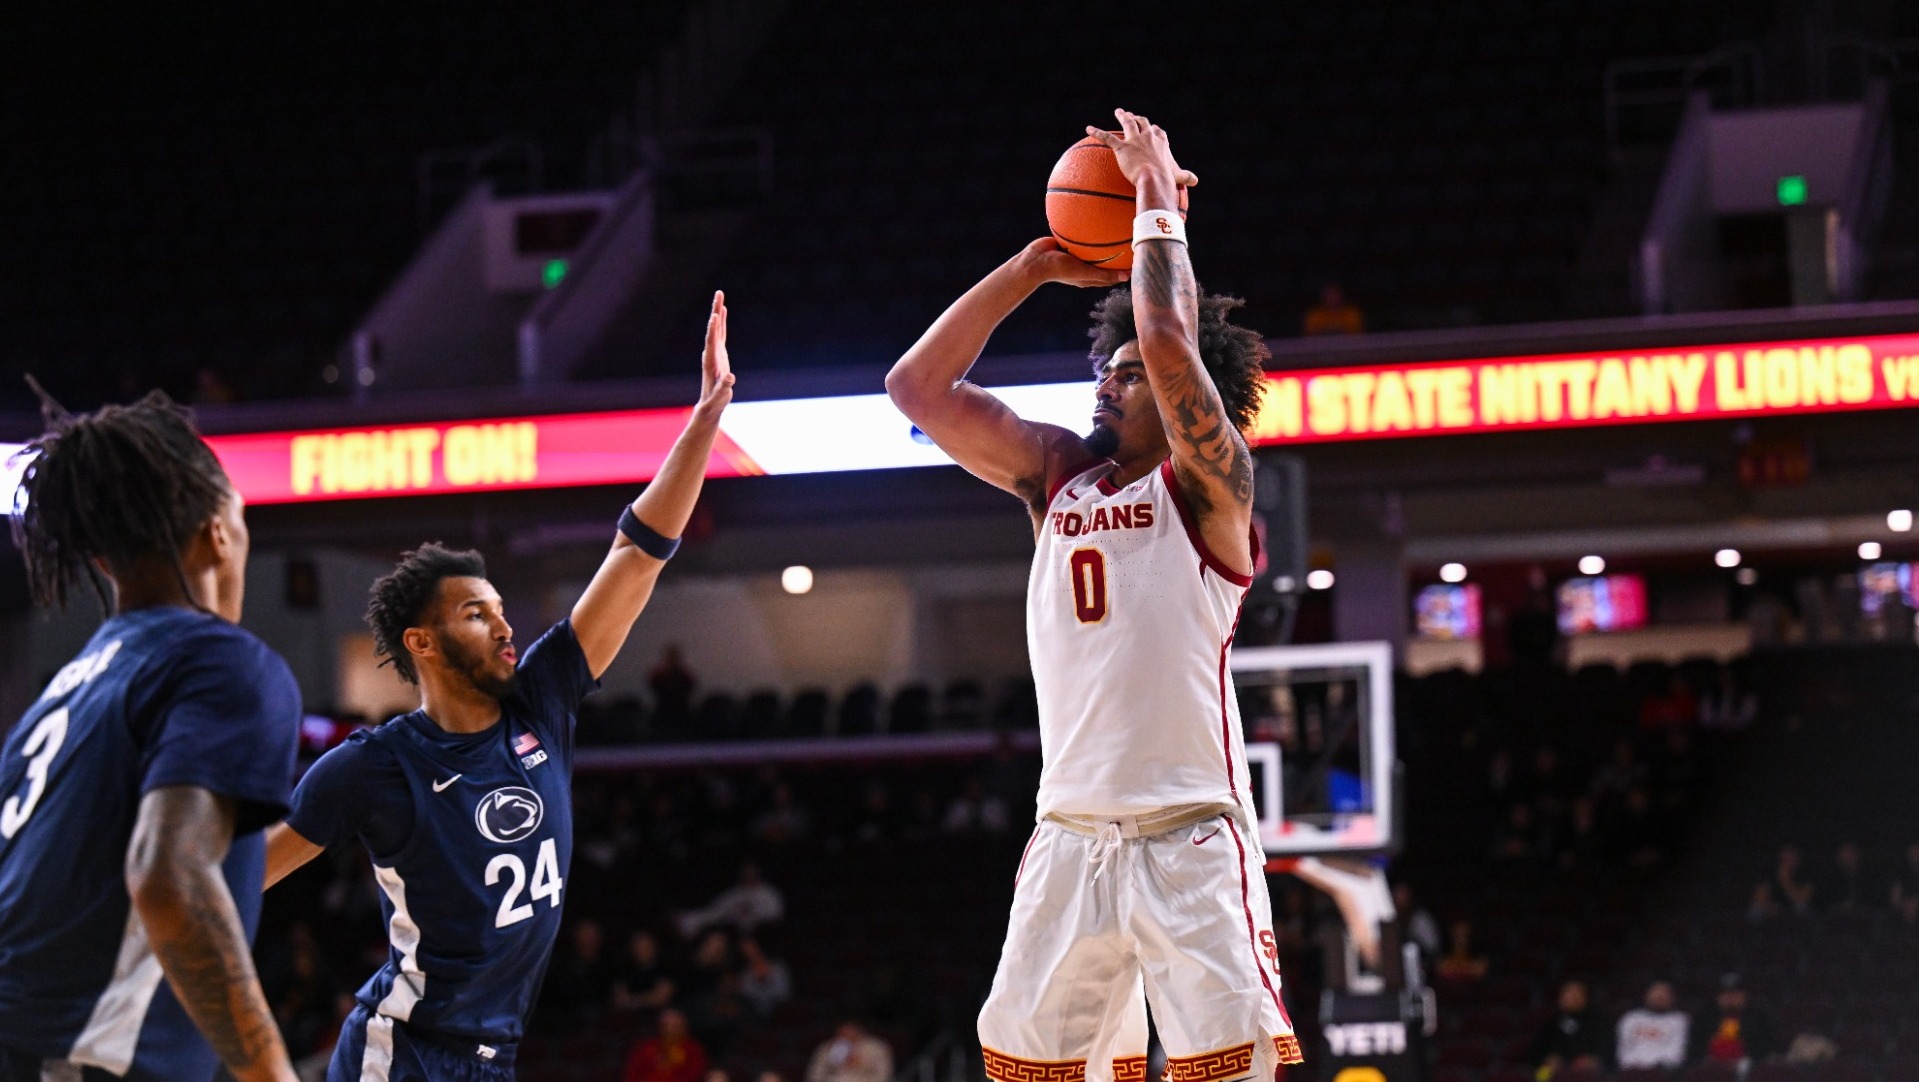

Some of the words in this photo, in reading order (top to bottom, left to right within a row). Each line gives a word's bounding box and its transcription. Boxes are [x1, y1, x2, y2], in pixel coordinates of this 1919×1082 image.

[1307, 366, 1473, 436] STATE
[1478, 352, 1708, 427] NITTANY
[1713, 344, 1873, 412] LIONS
[290, 427, 441, 496] FIGHT
[442, 421, 538, 486] ON!
[1070, 546, 1108, 625] 0
[0, 705, 70, 839] 3
[485, 837, 563, 928] 24
[1323, 1022, 1407, 1055] YETI
